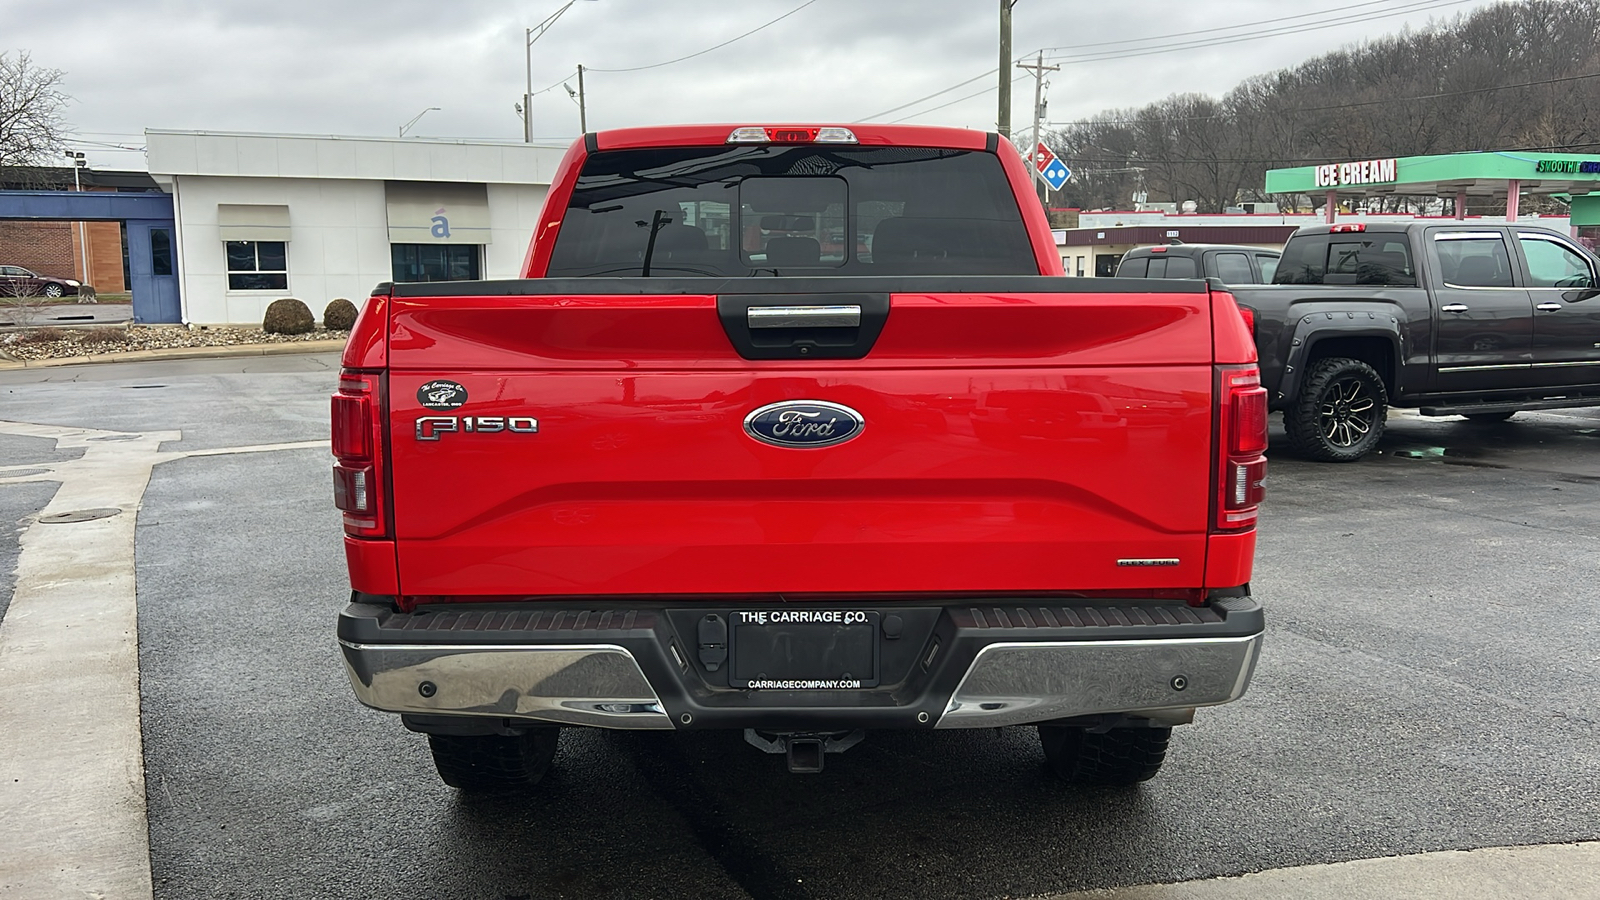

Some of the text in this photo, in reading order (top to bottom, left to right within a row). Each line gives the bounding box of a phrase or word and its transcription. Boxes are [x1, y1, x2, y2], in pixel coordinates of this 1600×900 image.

[1315, 159, 1397, 187] ICE CREAM
[772, 410, 837, 437] Ford
[740, 611, 869, 623] THE CARRIAGE CO.
[748, 680, 861, 689] CARRIAGECOMPANY.COM
